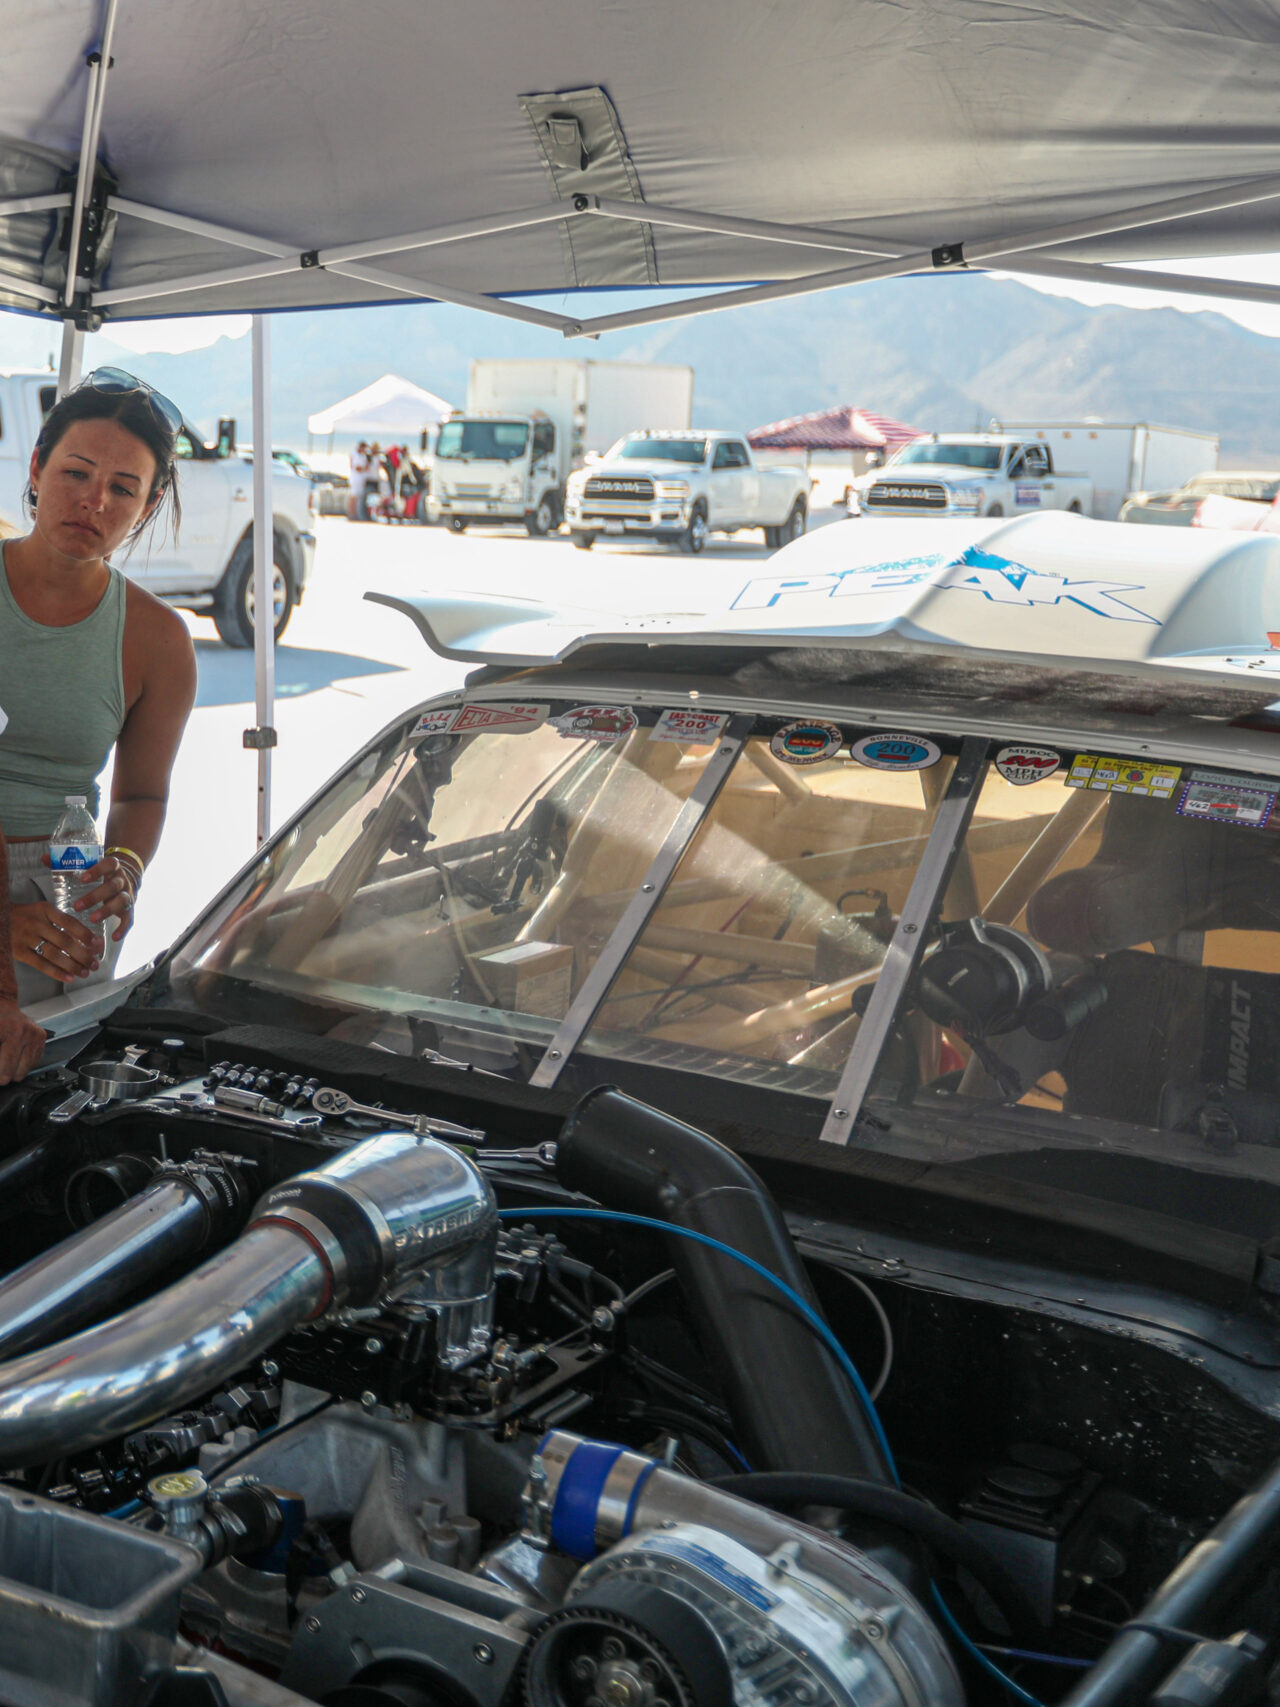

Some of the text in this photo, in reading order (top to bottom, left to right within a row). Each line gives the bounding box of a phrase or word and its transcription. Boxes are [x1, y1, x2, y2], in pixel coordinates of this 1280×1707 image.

[730, 563, 1163, 626] PEAK
[675, 719, 707, 729] 200
[870, 735, 929, 746] BONNEVILLE
[877, 741, 917, 755] 200
[1008, 748, 1056, 758] MUROC
[1004, 766, 1043, 777] MPH
[1228, 979, 1251, 1091] IMPACT
